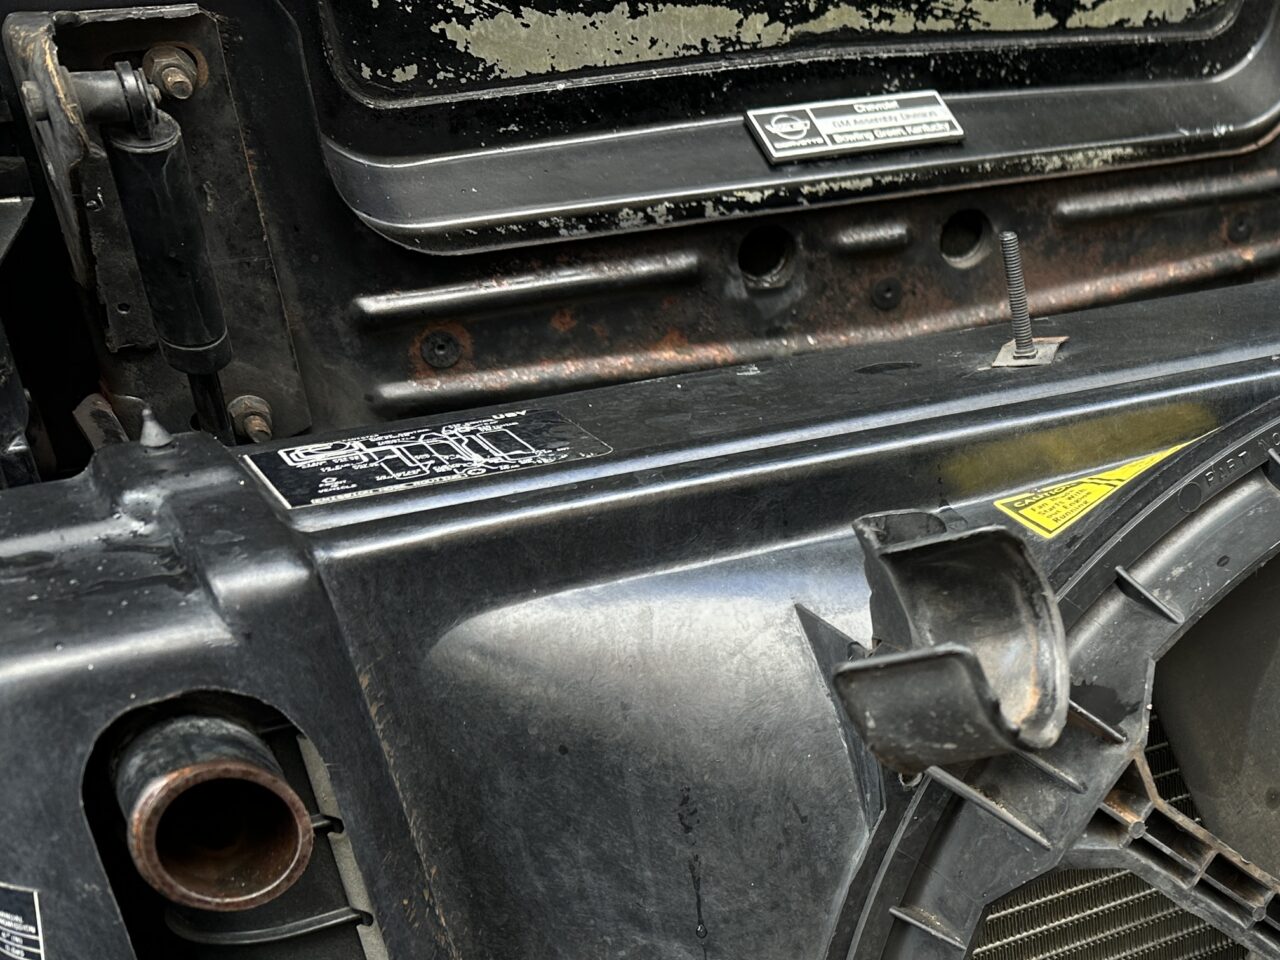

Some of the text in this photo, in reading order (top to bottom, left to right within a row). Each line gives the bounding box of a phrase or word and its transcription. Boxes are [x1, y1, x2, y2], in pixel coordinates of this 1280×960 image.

[853, 101, 900, 113] Chevrolet
[832, 119, 851, 130] GM
[833, 131, 876, 144] Bowling
[907, 122, 951, 136] Kentucky
[1205, 451, 1248, 488] PART
